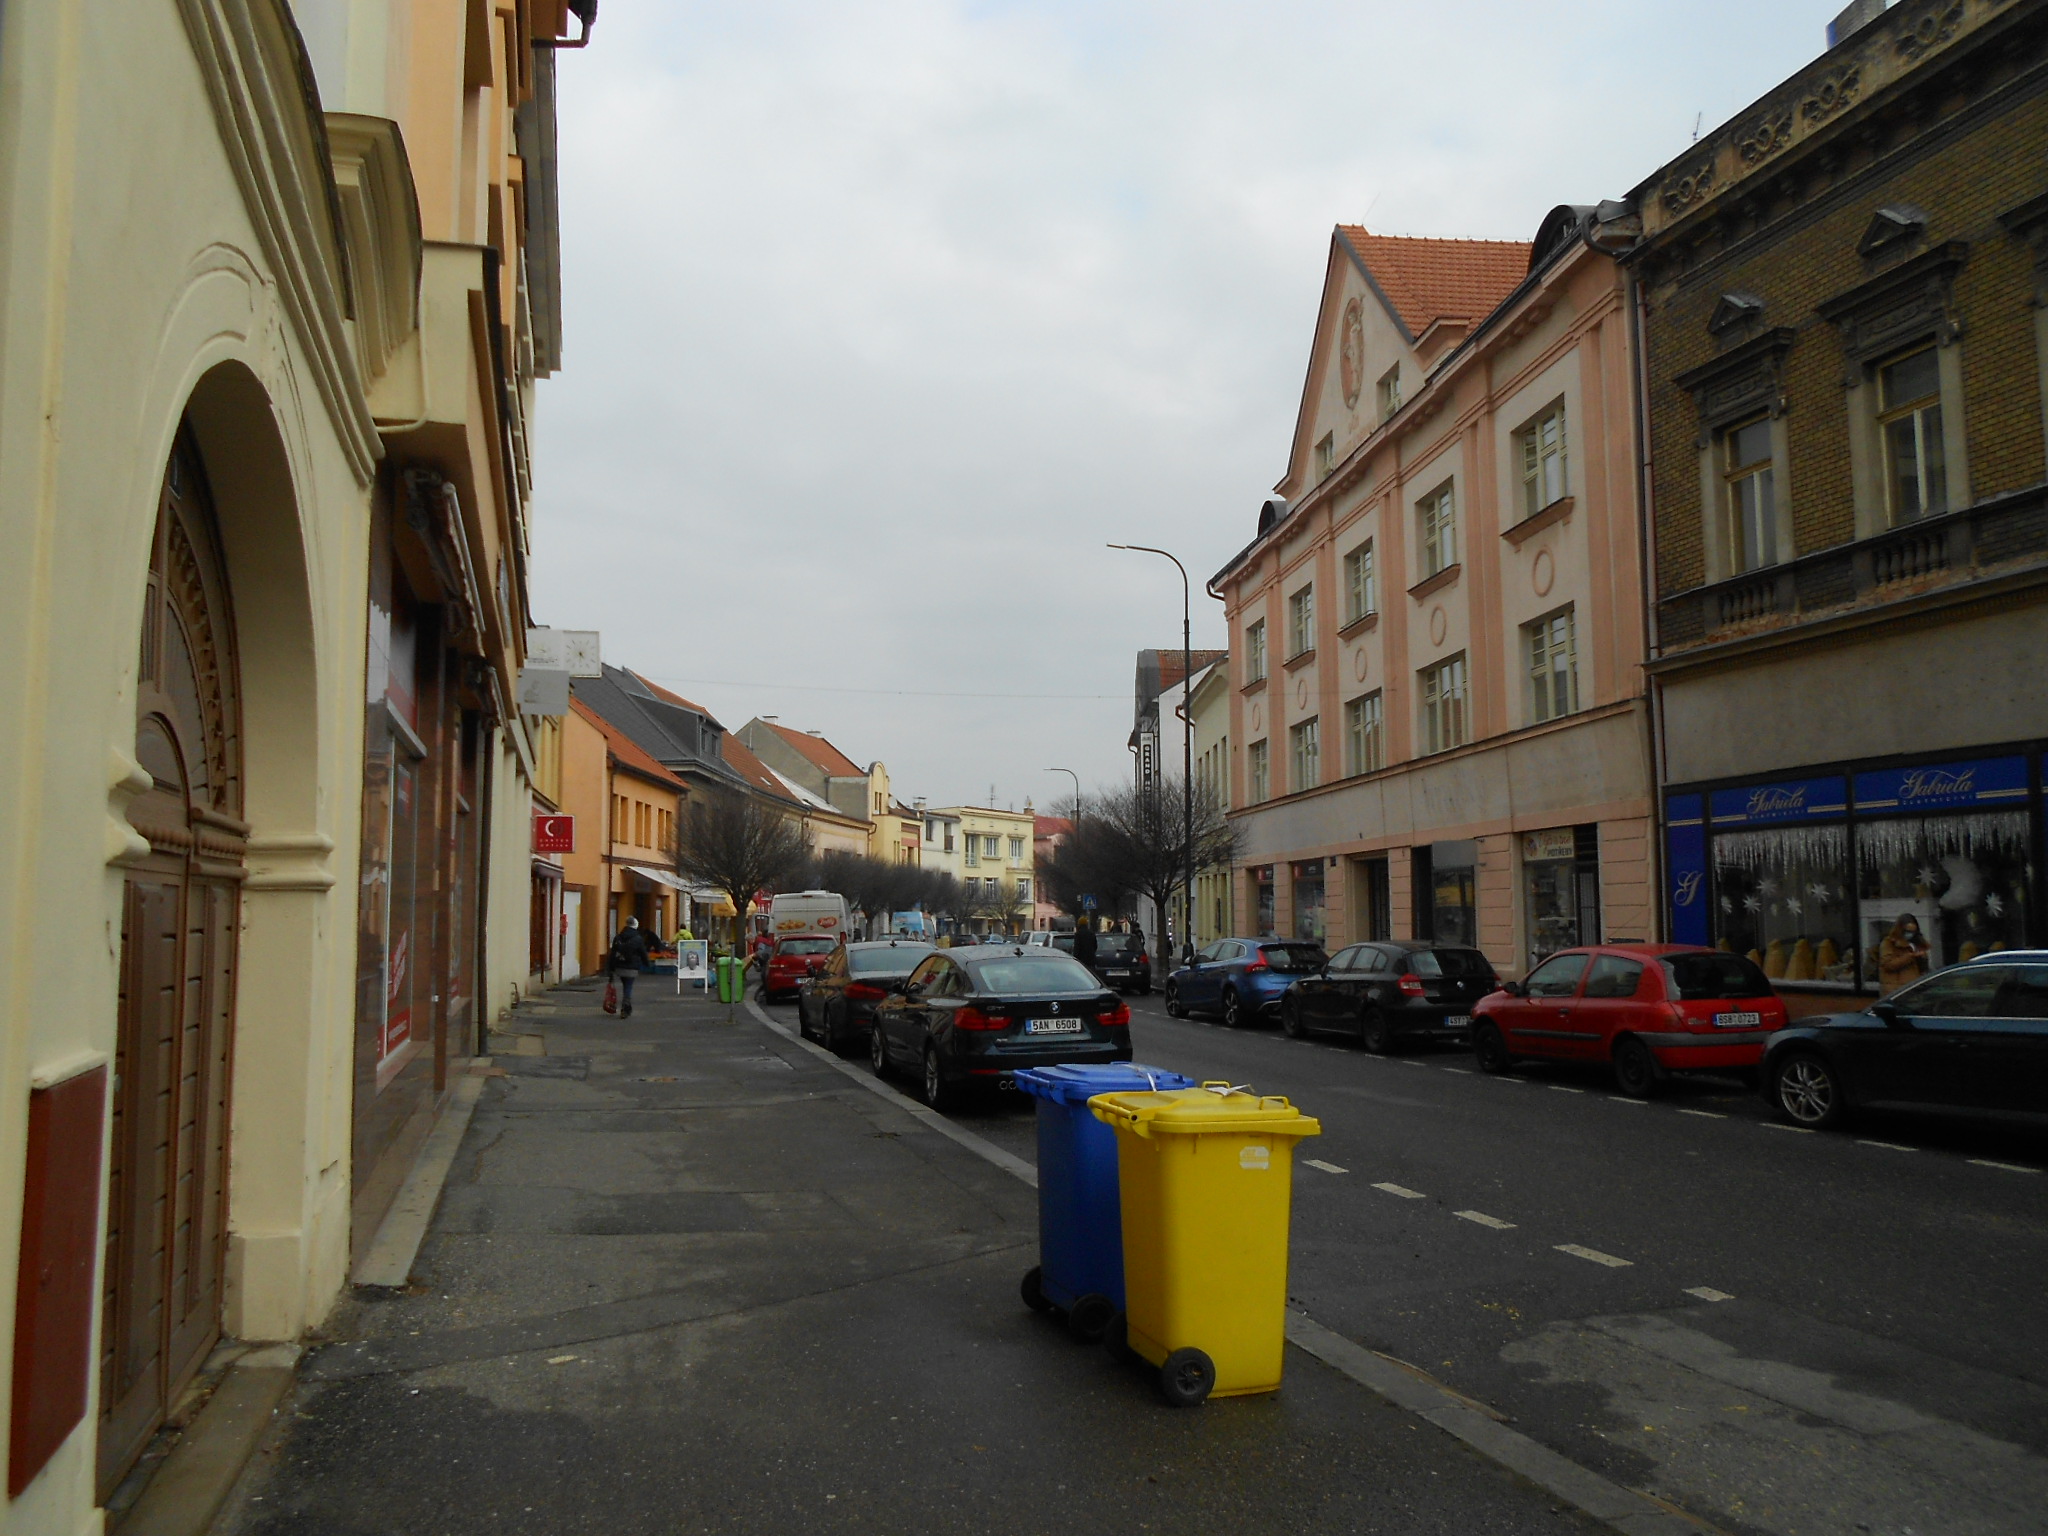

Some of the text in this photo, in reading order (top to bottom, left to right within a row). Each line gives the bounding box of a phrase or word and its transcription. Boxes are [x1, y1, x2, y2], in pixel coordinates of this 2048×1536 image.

[1899, 768, 1977, 799] Gabriela
[1746, 785, 1807, 814] Gabriela
[1032, 1020, 1077, 1030] 5AN 6508
